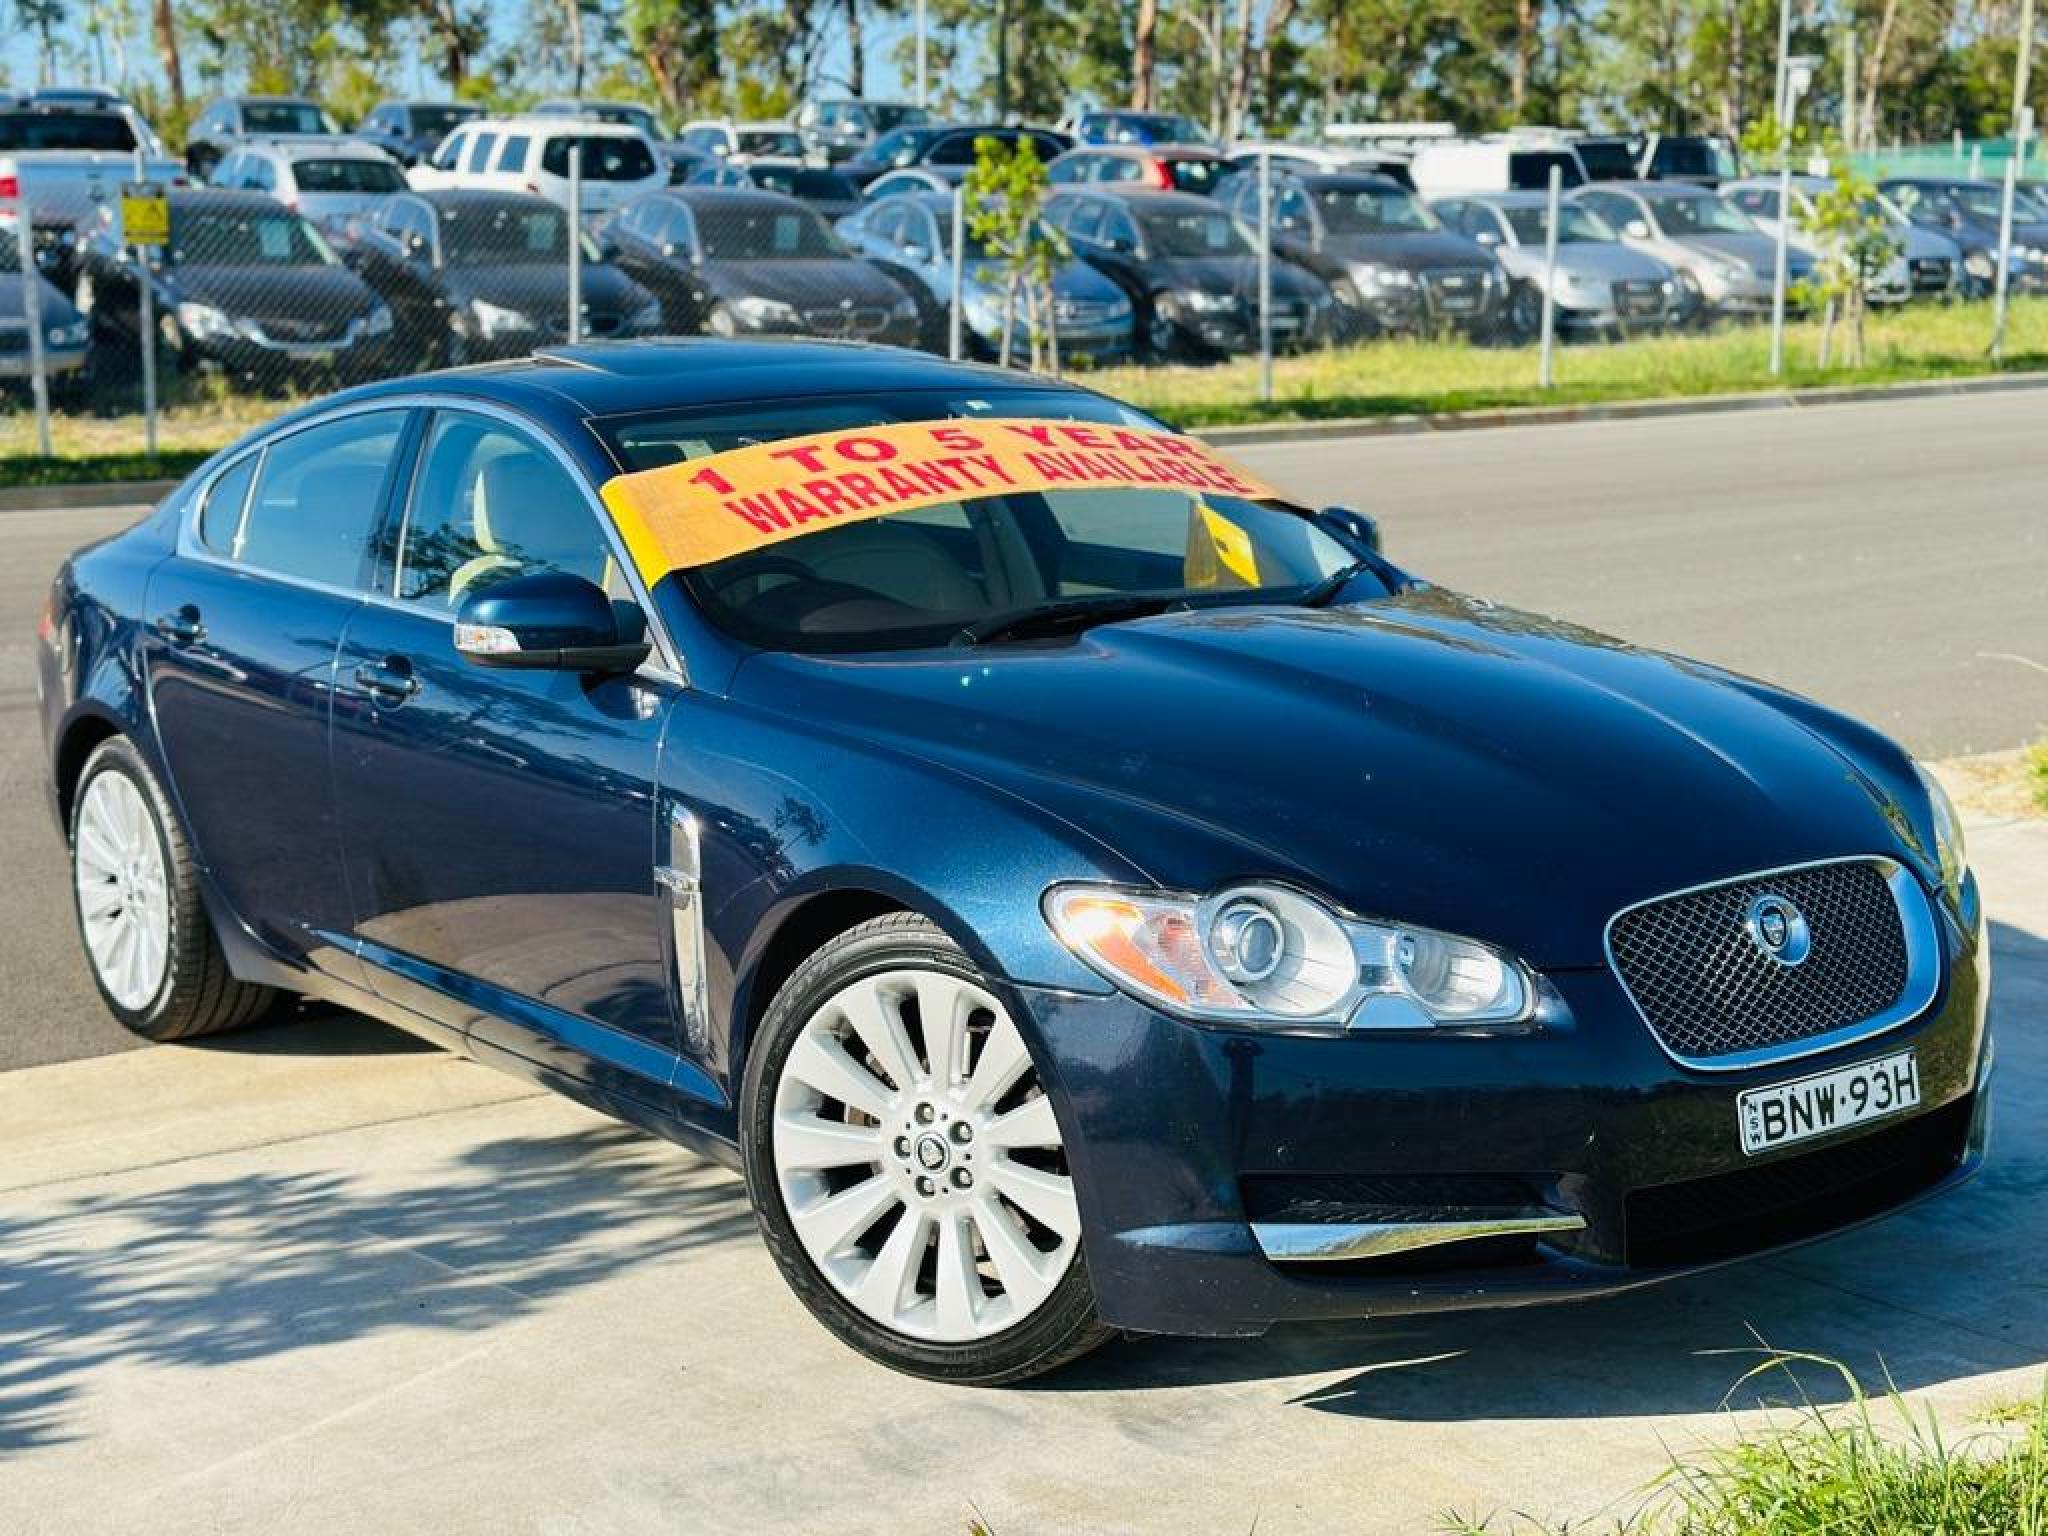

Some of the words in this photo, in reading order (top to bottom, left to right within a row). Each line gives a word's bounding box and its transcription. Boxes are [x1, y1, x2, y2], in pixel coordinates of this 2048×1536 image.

[689, 468, 735, 494] 1
[769, 437, 898, 472] TO
[929, 428, 984, 451] 5
[1002, 426, 1206, 460] YEAR
[723, 454, 1017, 533] WARRANTY
[1024, 452, 1254, 494] AVAILABLE
